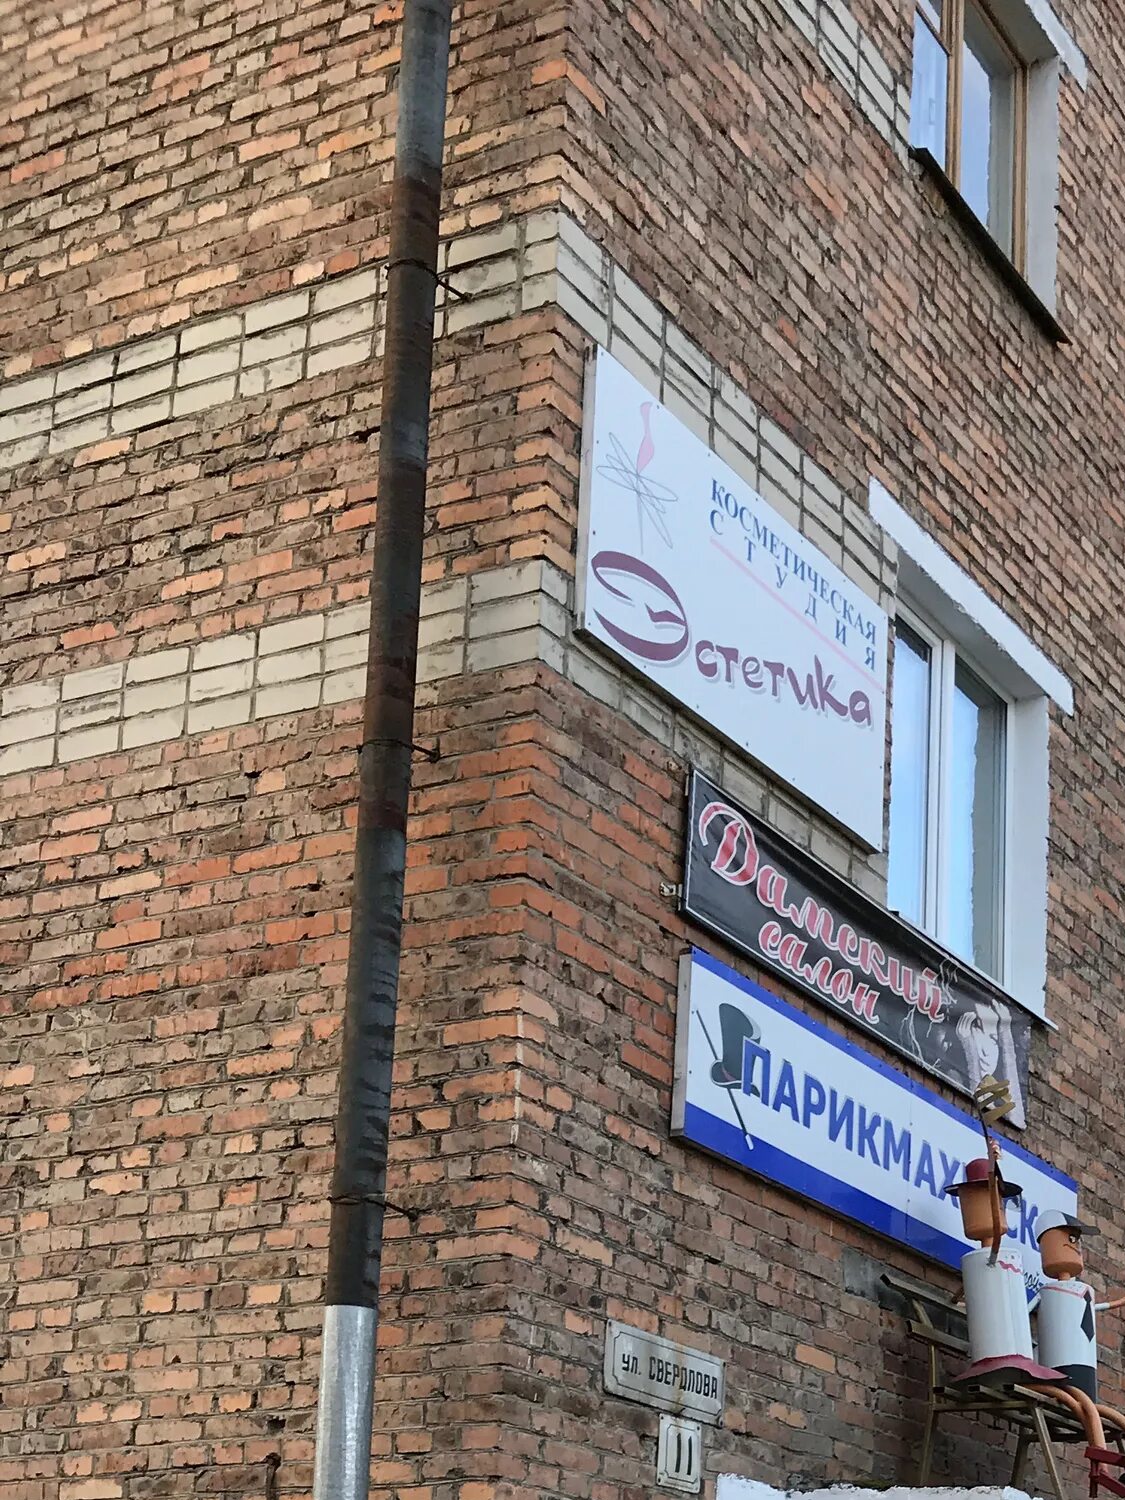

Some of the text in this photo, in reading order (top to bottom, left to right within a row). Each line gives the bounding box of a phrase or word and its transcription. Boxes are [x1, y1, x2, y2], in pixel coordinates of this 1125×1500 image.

[591, 550, 873, 727] Эстетика
[709, 508, 876, 672] СТУДИЯ
[710, 478, 877, 645] КОСМЕТИЧЕСКАЯ
[698, 801, 946, 1022] Дамский
[758, 920, 881, 1025] салон
[741, 1040, 1042, 1253] ПАРИКМАХСК
[648, 1356, 718, 1400] СВЕРДЛОВА
[674, 1432, 692, 1476] 11
